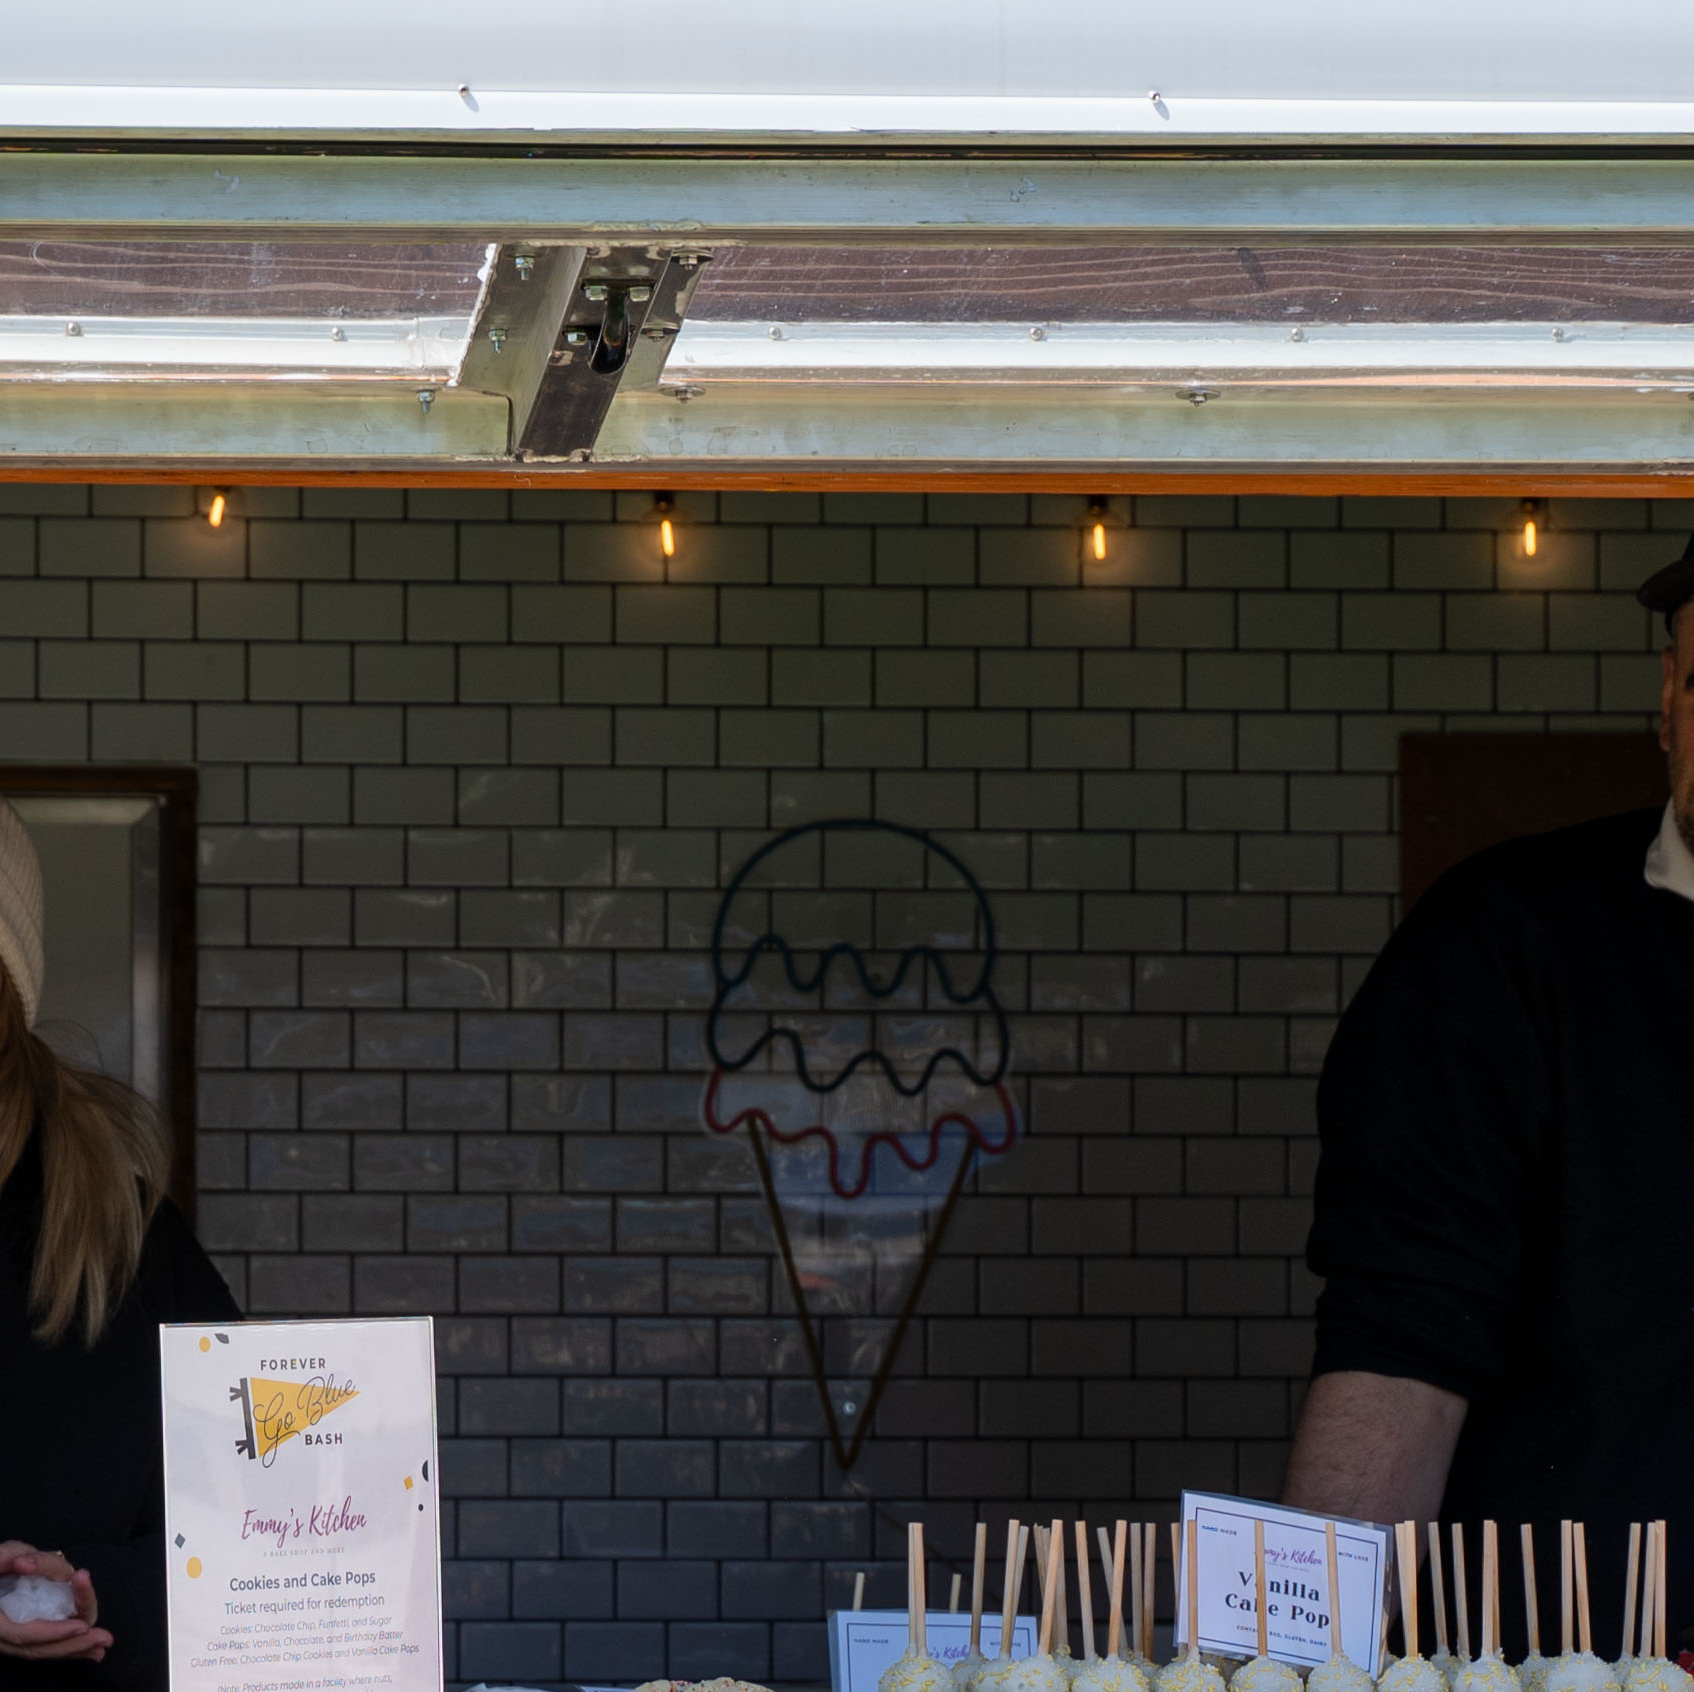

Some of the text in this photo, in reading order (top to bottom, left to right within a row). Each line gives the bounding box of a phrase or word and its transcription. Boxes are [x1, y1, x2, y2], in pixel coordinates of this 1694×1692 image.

[260, 1358, 326, 1371] FOREVER
[253, 1373, 356, 1468] Go Blue
[305, 1433, 343, 1445] BASH
[241, 1495, 367, 1549] Emmy's Kitchen
[327, 1546, 345, 1554] MORE
[1290, 1548, 1323, 1566] Kitchen
[229, 1571, 376, 1591] Cookies and Cake Pops
[1238, 1571, 1321, 1602] Vnilla
[225, 1594, 385, 1615] Ticket required for redemption
[254, 1622, 295, 1633] Chocolate
[352, 1617, 367, 1626] and
[369, 1616, 392, 1627] Sugar
[1290, 1605, 1331, 1629] Pop
[207, 1641, 227, 1652] Cake
[326, 1634, 342, 1644] and
[344, 1631, 377, 1643] Birthday
[378, 1630, 403, 1640] Batter
[190, 1657, 217, 1668] Gluten
[240, 1653, 281, 1665] Chocolate
[282, 1651, 302, 1662] Chip
[303, 1649, 332, 1660] Cookies
[334, 1648, 350, 1658] and
[351, 1646, 378, 1657] Vanilla
[379, 1645, 398, 1655] Cake
[400, 1644, 420, 1655] Pops
[279, 1679, 305, 1690] made
[322, 1676, 346, 1689] facility
[348, 1674, 372, 1685] where
